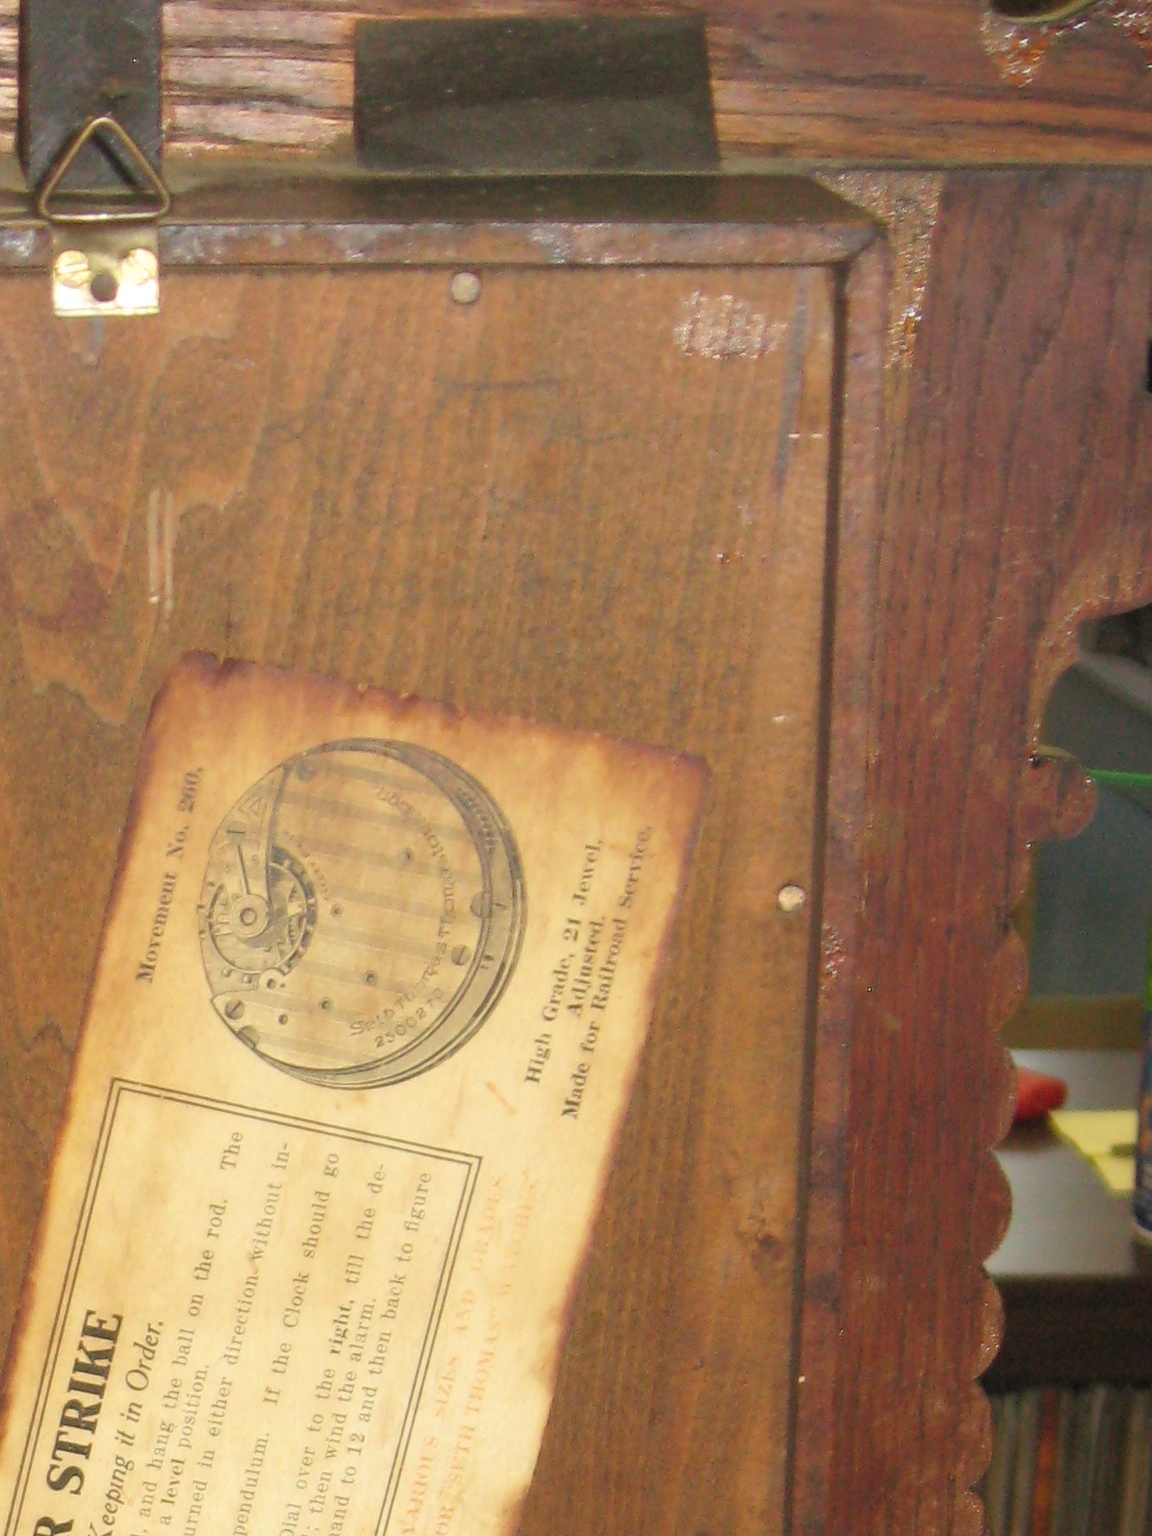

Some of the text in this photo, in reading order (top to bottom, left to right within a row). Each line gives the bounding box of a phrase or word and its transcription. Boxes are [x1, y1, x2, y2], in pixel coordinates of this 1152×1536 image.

[133, 871, 178, 984] Movement
[165, 824, 190, 860] No.
[559, 825, 652, 1120] Made for Railroad Service.
[565, 915, 606, 1018] Adjusted.
[522, 1032, 552, 1084] High
[540, 952, 575, 1022] Grade,
[562, 916, 582, 942] 21
[402, 1172, 431, 1232] figure
[124, 1320, 164, 1392] Order.
[206, 1376, 233, 1437] either
[221, 1275, 259, 1365] direction
[247, 1182, 282, 1263] without
[232, 1432, 270, 1536] pendulum.
[281, 1271, 310, 1328] Clock
[300, 1189, 330, 1259] should
[367, 1331, 392, 1375] then
[379, 1273, 406, 1319] back
[45, 1308, 124, 1496] STRIKE
[113, 1428, 136, 1447] it
[118, 1400, 143, 1423] in
[145, 1419, 177, 1470] hang
[170, 1328, 195, 1366] ball
[159, 1457, 185, 1505] level
[177, 1364, 209, 1449] position.
[295, 1445, 315, 1490] over
[327, 1299, 355, 1355] right,
[343, 1253, 364, 1284] till
[308, 1471, 332, 1513] then
[324, 1412, 347, 1459] wind
[347, 1298, 376, 1362] alarm.
[345, 1432, 365, 1455] 12
